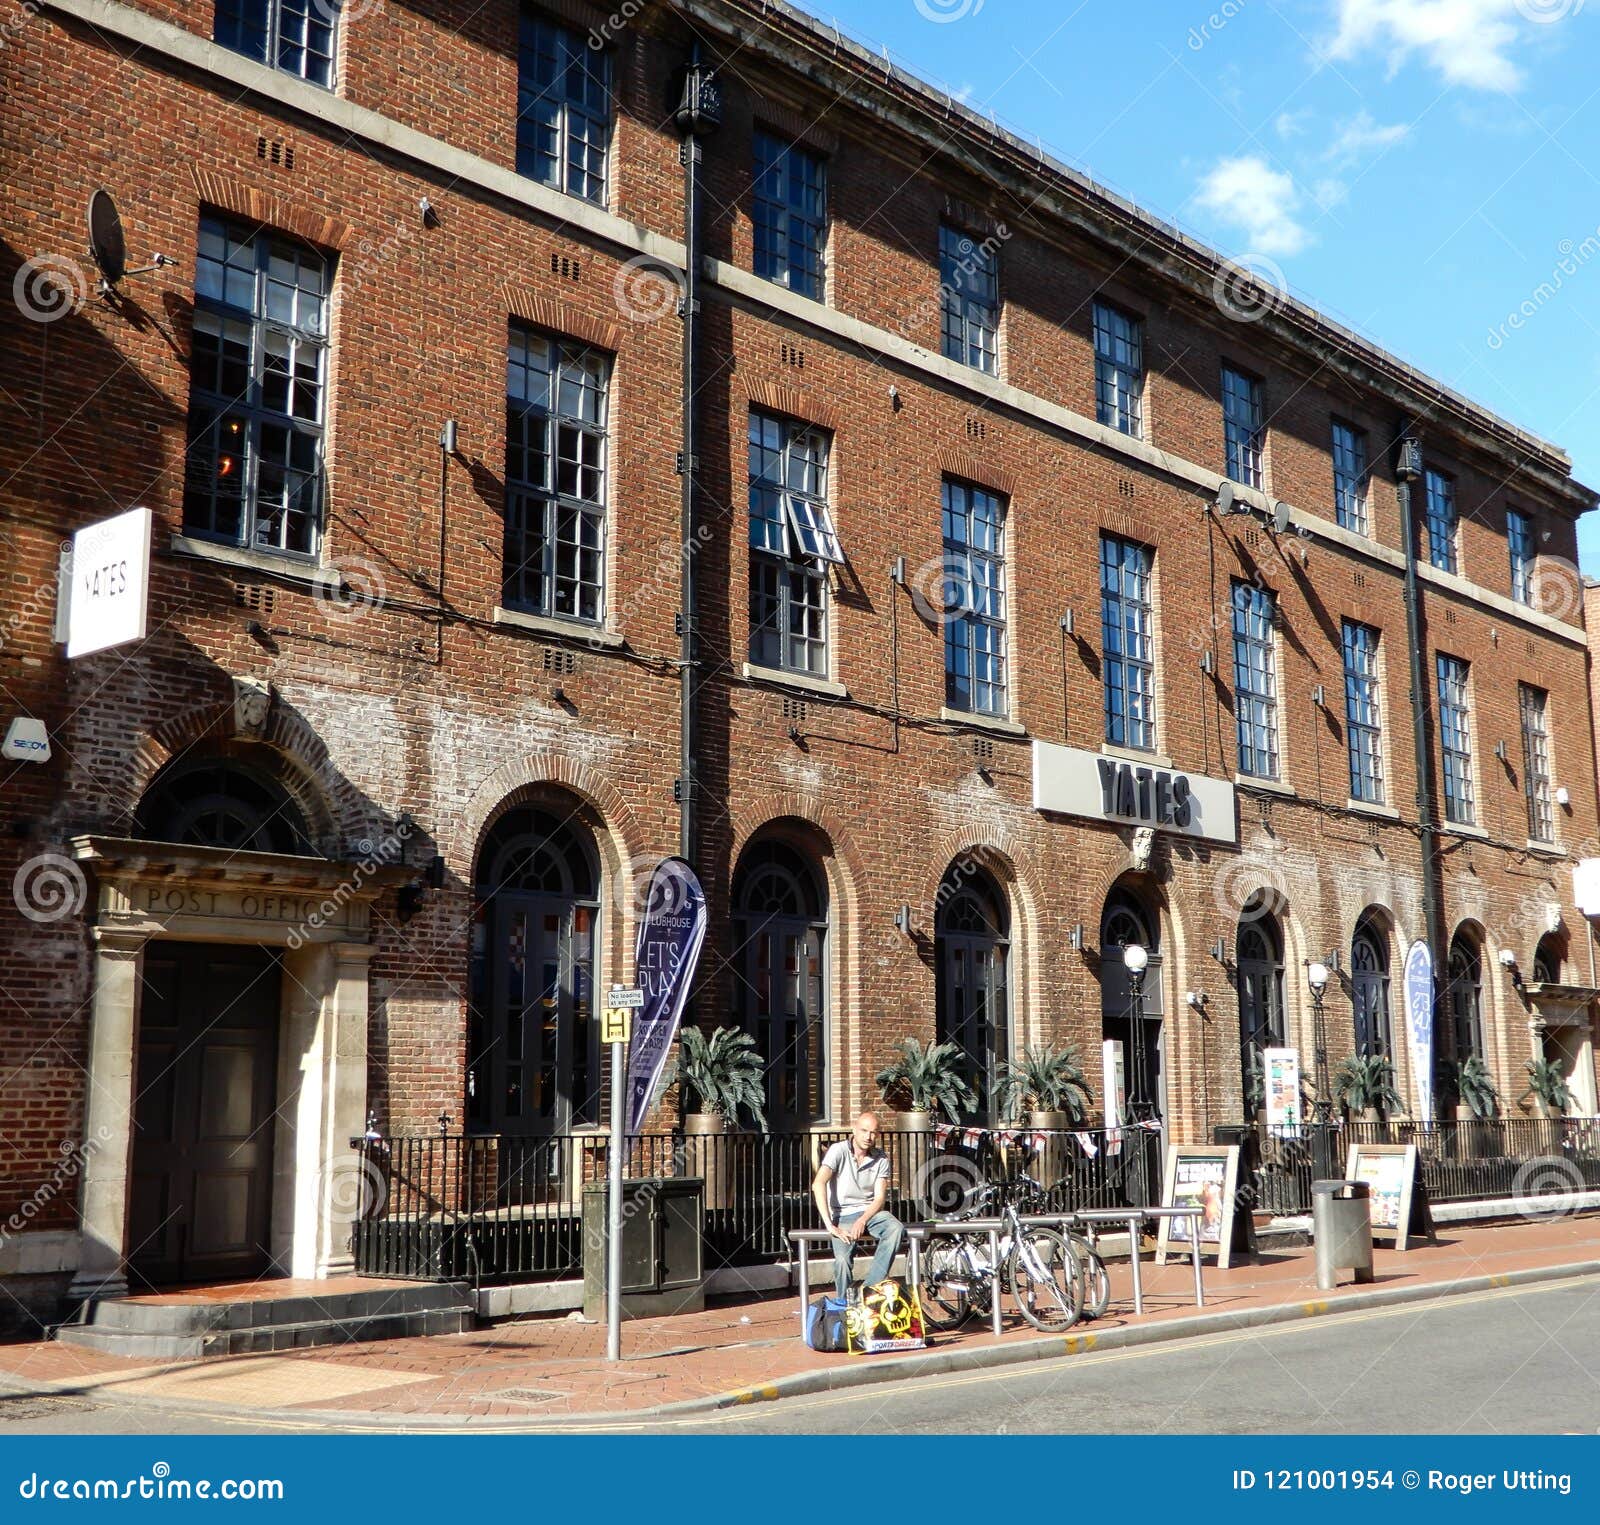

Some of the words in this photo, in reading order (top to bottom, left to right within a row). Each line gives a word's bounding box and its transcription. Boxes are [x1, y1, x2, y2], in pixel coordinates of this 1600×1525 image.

[1097, 758, 1192, 828] YATES
[148, 887, 222, 914] POST
[241, 894, 336, 925] OFFIC
